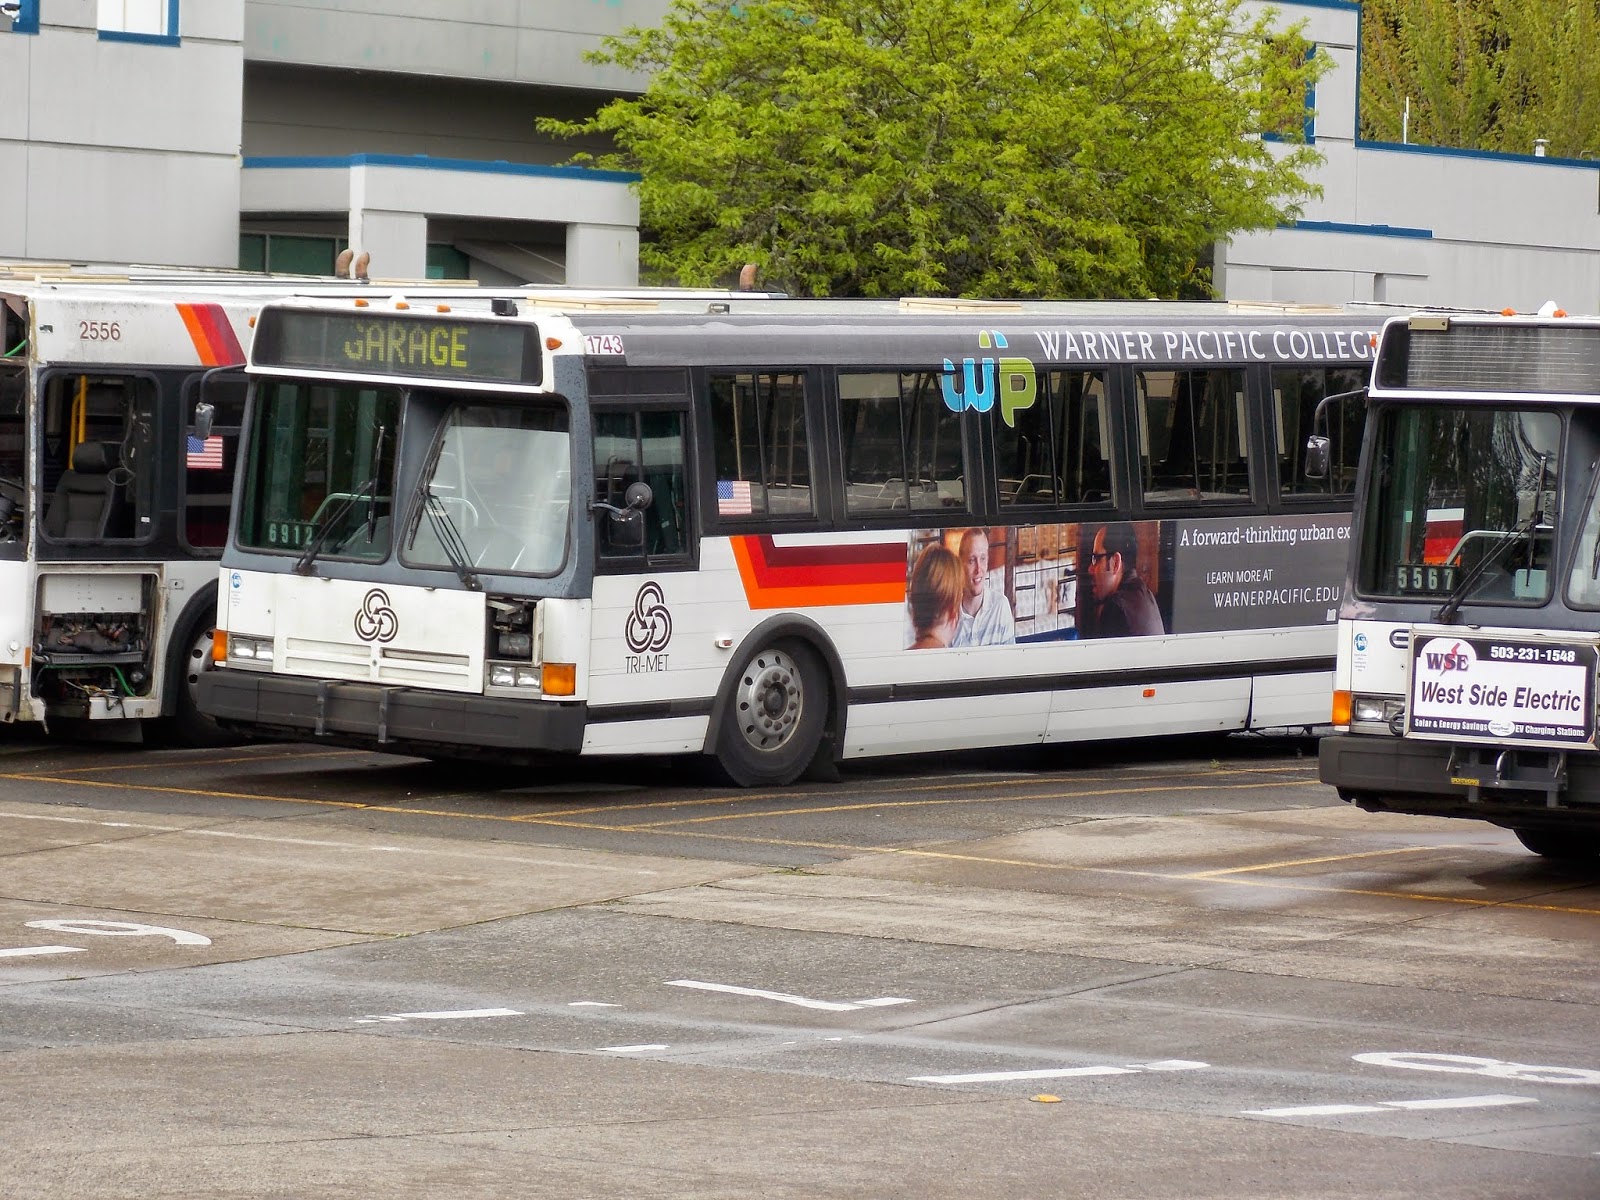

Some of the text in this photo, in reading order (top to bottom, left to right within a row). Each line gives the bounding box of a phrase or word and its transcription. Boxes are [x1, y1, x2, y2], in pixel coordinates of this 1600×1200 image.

[79, 320, 121, 341] 2556
[344, 320, 468, 368] GARAGE
[587, 335, 624, 355] 1743
[1034, 330, 1157, 360] WARNER
[1164, 330, 1267, 360] PACIFIC
[269, 523, 313, 546] 6912
[1180, 529, 1190, 547] A
[1192, 525, 1298, 546] forward-thinking
[1300, 523, 1335, 542] urban
[1206, 568, 1274, 585] LEARN MORE AT
[1399, 566, 1454, 591] 5567
[1213, 586, 1340, 608] WARNERPACIFIC.EDU
[625, 653, 670, 674] TRI-MET
[1425, 652, 1470, 672] WSE
[1490, 645, 1576, 663] 503-231-1548
[1421, 681, 1581, 712] West Side Electric
[1414, 718, 1432, 728] Solar
[1433, 720, 1438, 728] &
[1439, 720, 1461, 730] Energy
[1462, 721, 1488, 732] Savings
[1515, 724, 1524, 733] EV
[1525, 725, 1556, 736] Charging
[1556, 726, 1585, 737] Stations
